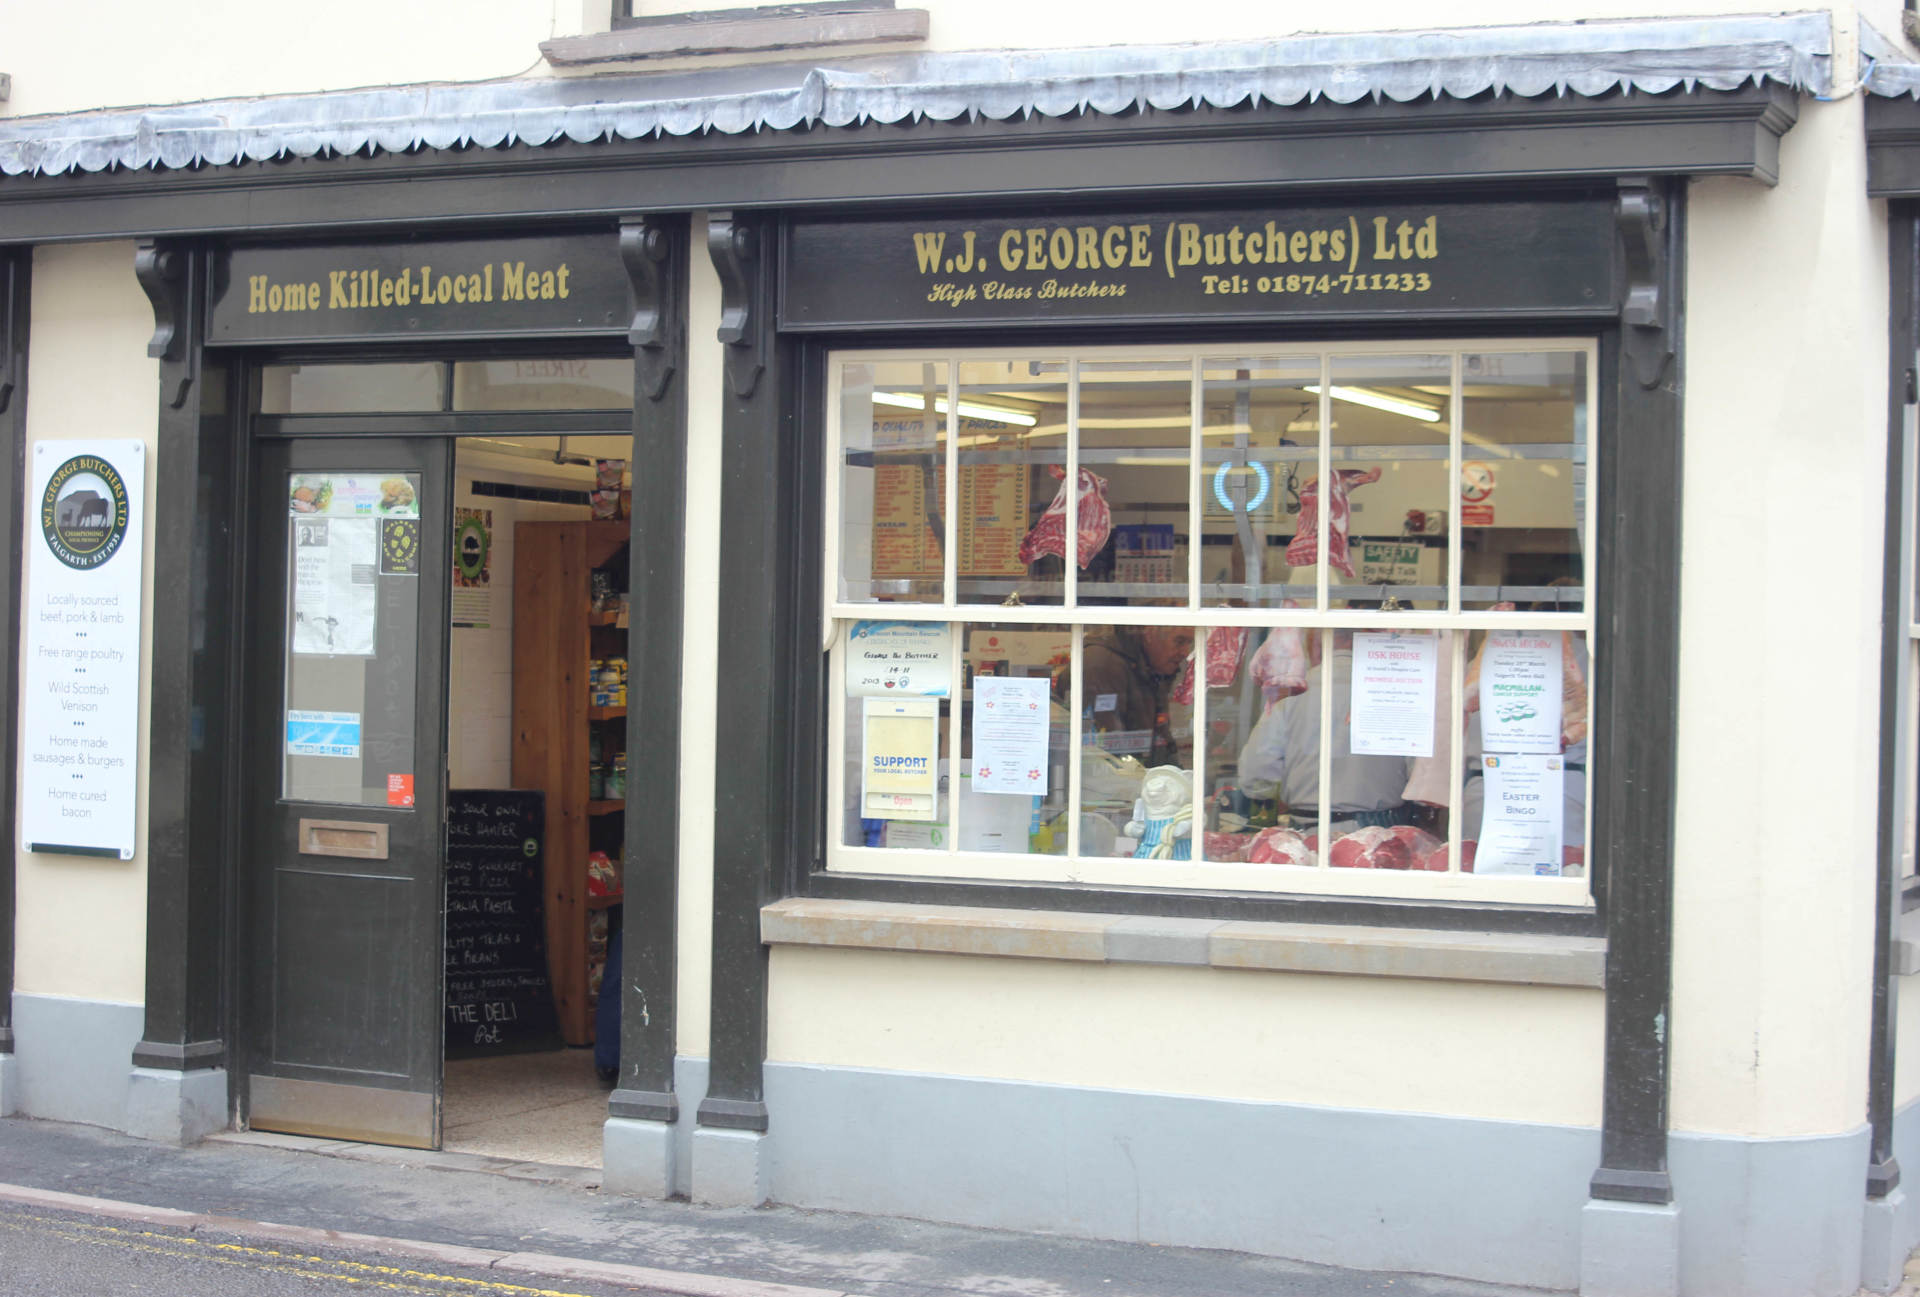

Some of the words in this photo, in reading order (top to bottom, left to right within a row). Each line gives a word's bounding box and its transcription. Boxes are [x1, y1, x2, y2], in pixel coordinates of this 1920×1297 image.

[913, 231, 987, 274] W.J.
[1000, 225, 1152, 272] GEORGE
[1164, 216, 1361, 278] (Butchers)
[1372, 216, 1438, 261] Ltd
[249, 275, 320, 313] Home
[502, 261, 570, 302] Meat
[1202, 275, 1249, 295] Tel:
[1256, 273, 1431, 295] 01874-711233
[927, 282, 965, 308] High
[981, 280, 1033, 302] Class
[1037, 278, 1127, 300] Butchers
[46, 460, 80, 503] GEORGE
[80, 458, 125, 499] BUTCHERS
[118, 501, 127, 527] LTD
[49, 533, 88, 566] TALGARTH
[93, 550, 108, 563] EST
[47, 593, 78, 608] Locally
[80, 593, 119, 606] sourced
[40, 609, 64, 623] beef,
[66, 609, 87, 624] pork
[90, 610, 97, 622] &
[100, 609, 124, 623] lamb
[39, 645, 59, 657] Free
[61, 648, 88, 661] range
[90, 647, 125, 663] poultry
[1367, 650, 1387, 660] USK
[1389, 651, 1421, 661] HOUSE
[48, 681, 70, 693] Wild
[72, 681, 109, 695] Scottish
[61, 700, 98, 712] Venison
[49, 734, 78, 747] Home
[80, 735, 109, 748] made
[32, 753, 76, 767] sausages
[77, 753, 85, 764] &
[87, 752, 125, 769] burgers
[873, 755, 928, 768] SUPPORT
[48, 786, 77, 800] Home
[79, 788, 107, 802] cured
[61, 804, 92, 818] bacon
[448, 1003, 479, 1024] THE
[484, 1001, 518, 1022] DELI
